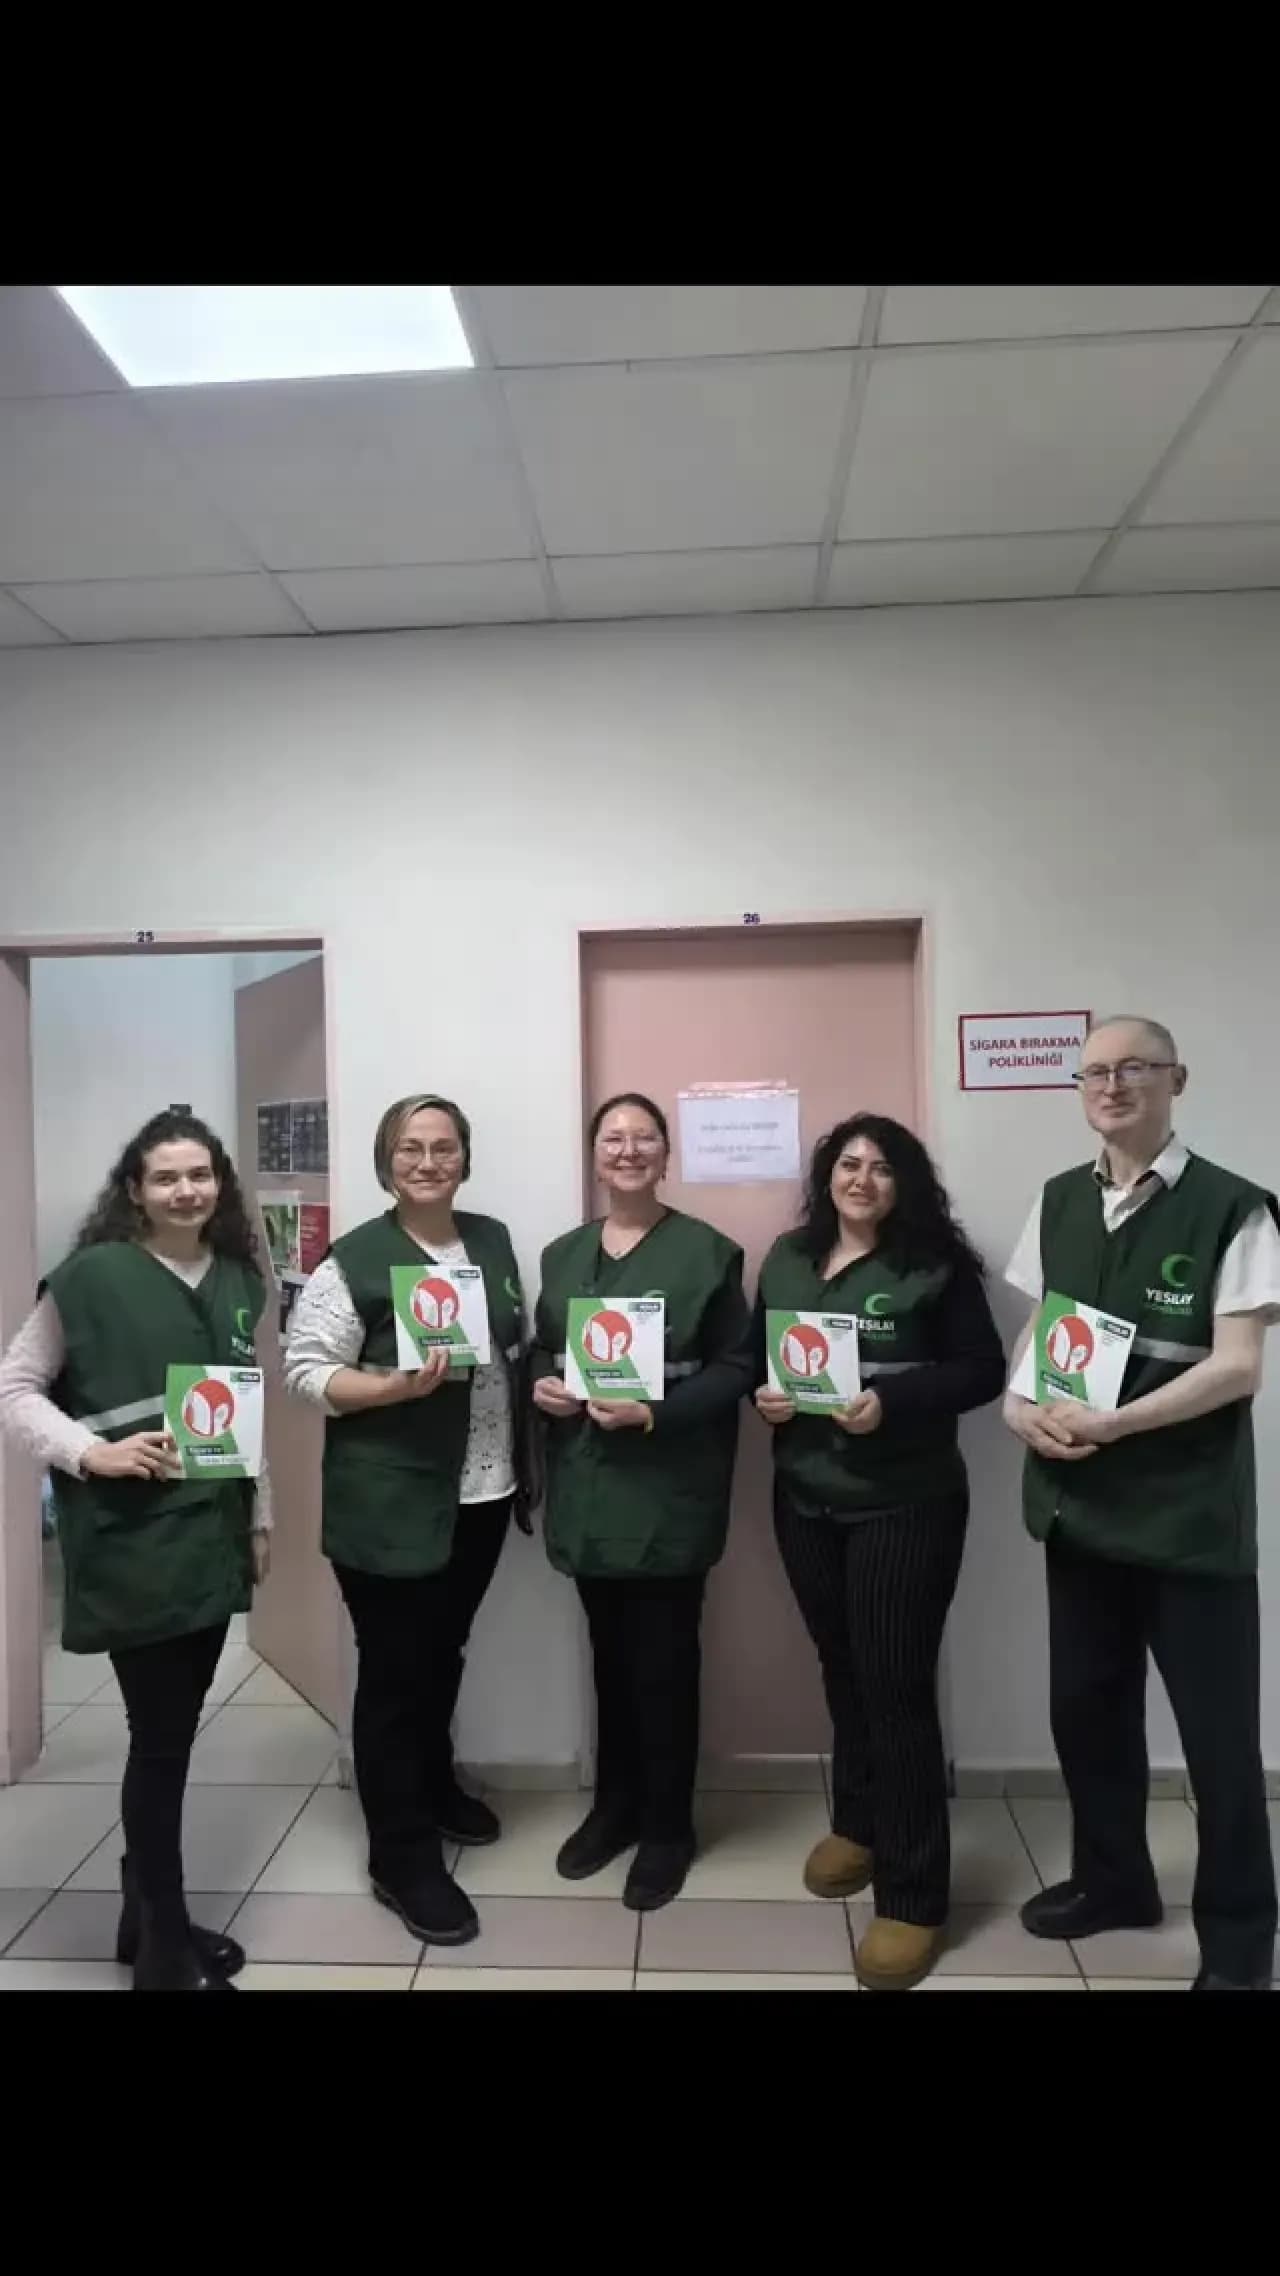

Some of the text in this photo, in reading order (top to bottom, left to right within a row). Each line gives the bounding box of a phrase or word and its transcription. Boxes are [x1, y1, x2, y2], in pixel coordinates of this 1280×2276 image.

[743, 912, 760, 925] 26
[969, 1036, 1081, 1051] SİGARA BIRAKMA
[989, 1051, 1063, 1068] POLİKLİNİĞİ
